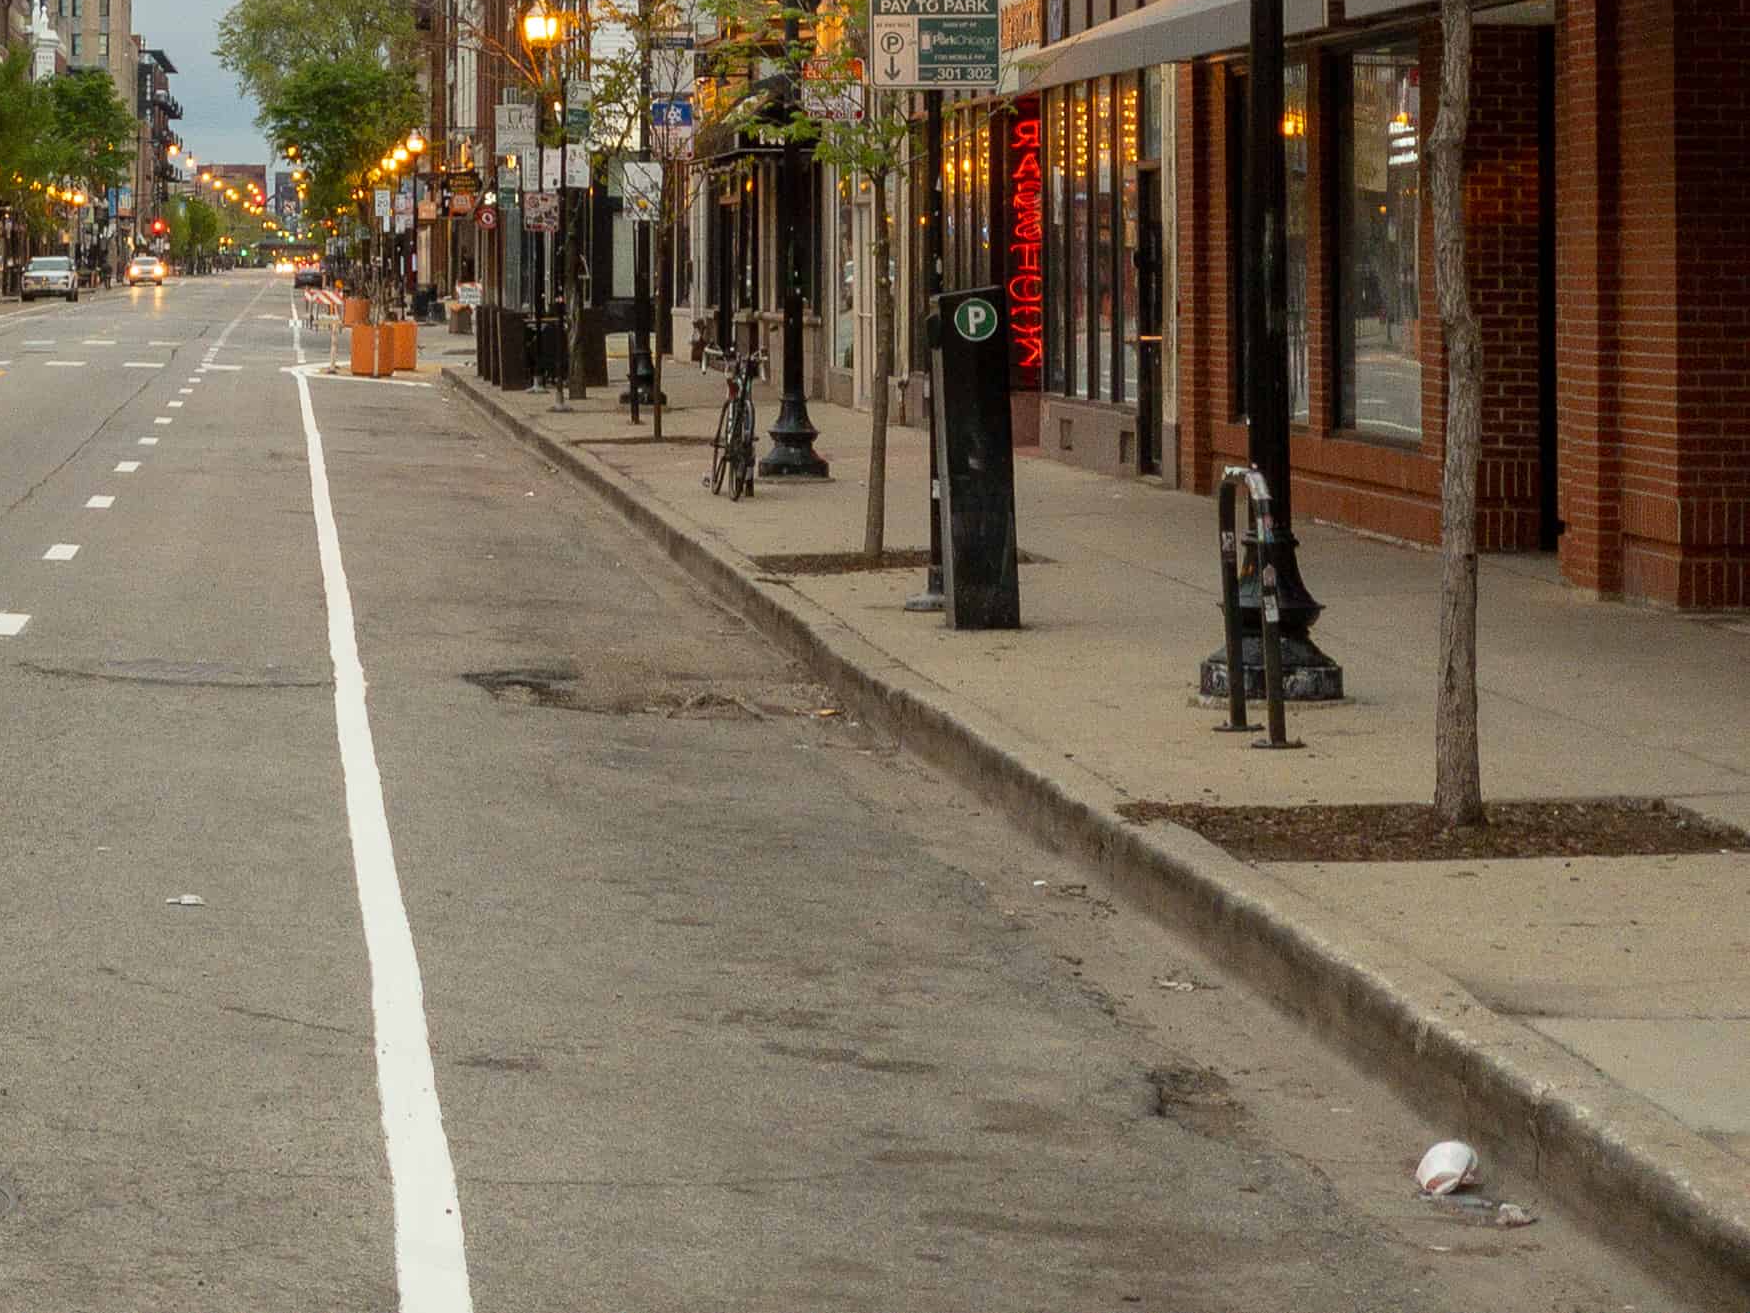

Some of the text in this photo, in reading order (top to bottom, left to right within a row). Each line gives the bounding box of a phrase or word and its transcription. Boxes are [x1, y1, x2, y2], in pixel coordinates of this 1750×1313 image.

[879, 0, 989, 13] PAY TO PARK
[932, 32, 995, 50] ParkChicago
[937, 68, 961, 80] 301
[967, 68, 993, 80] 302
[968, 305, 987, 335] P
